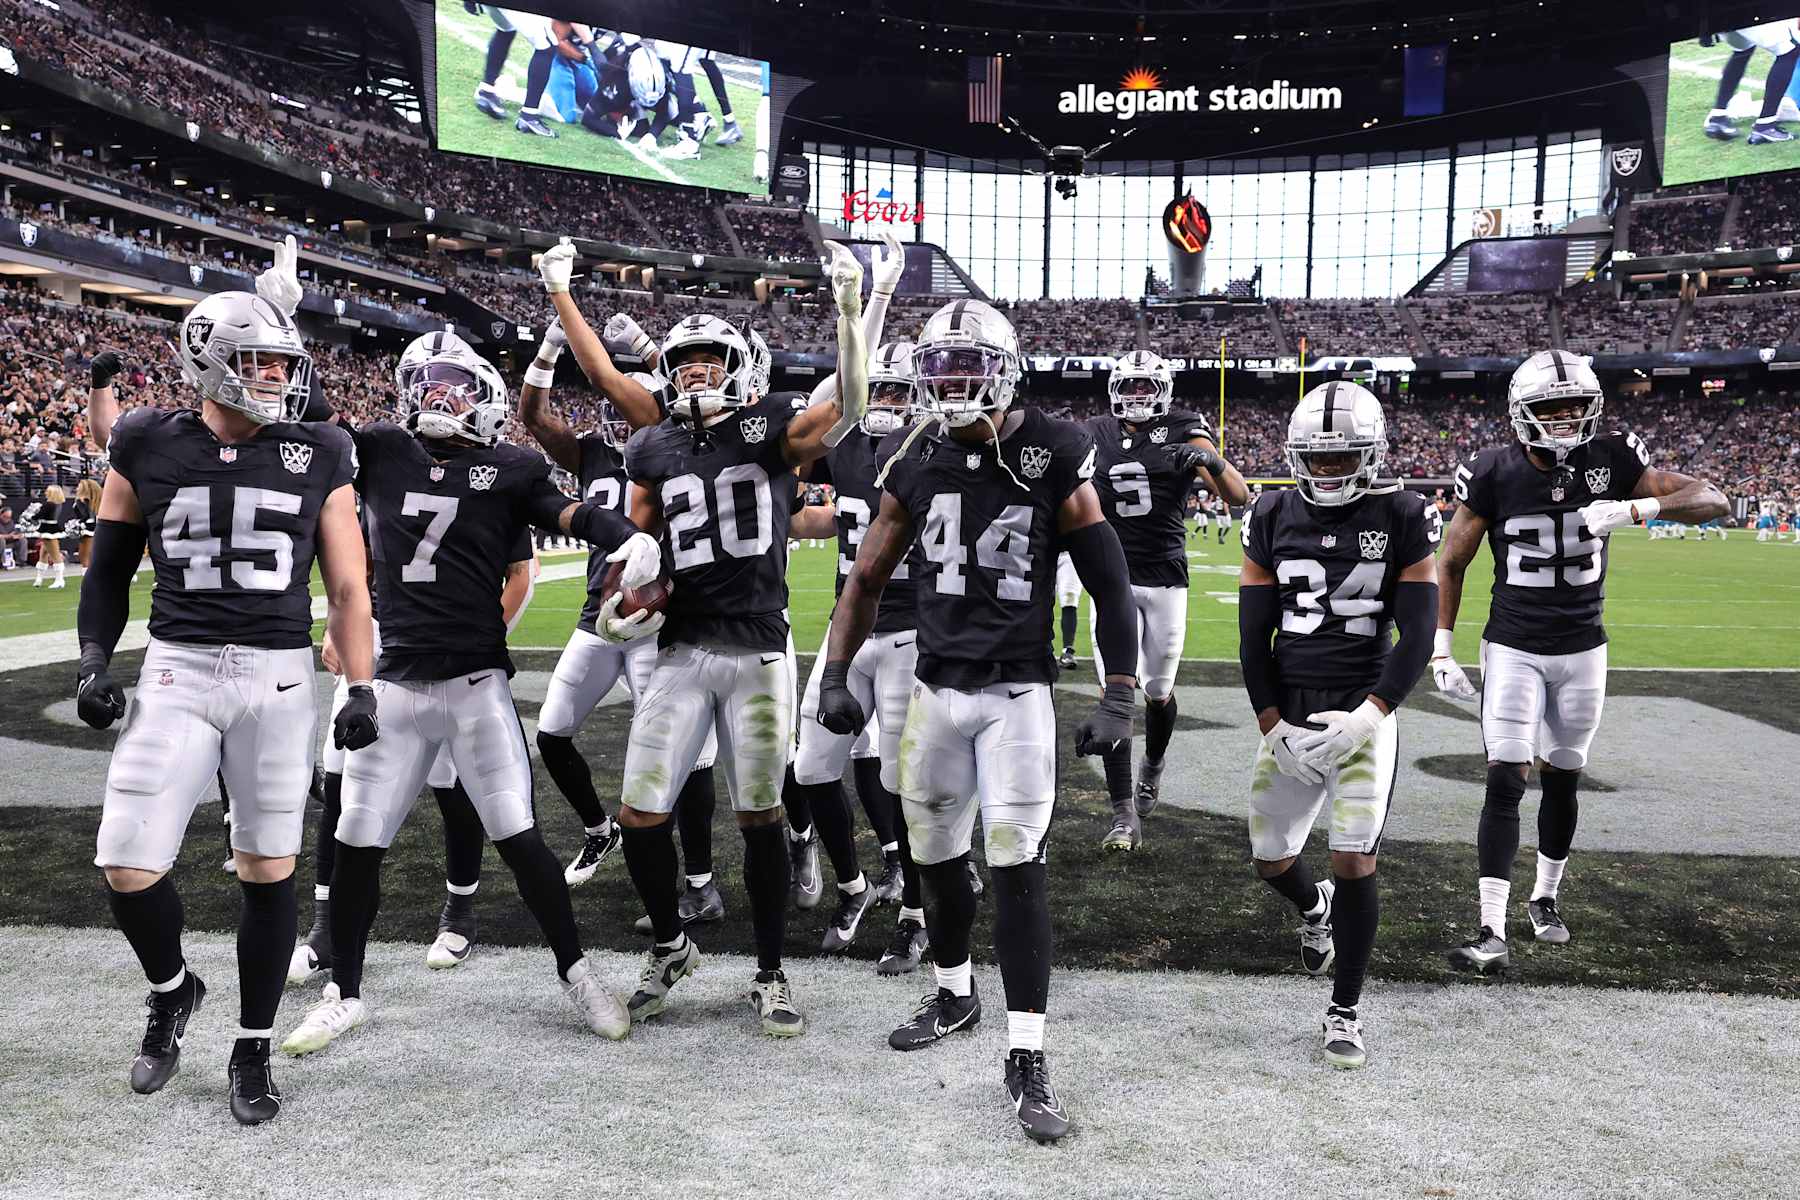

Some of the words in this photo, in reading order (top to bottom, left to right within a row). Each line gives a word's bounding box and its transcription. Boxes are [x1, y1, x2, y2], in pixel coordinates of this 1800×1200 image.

[1057, 84, 1199, 120] allegiant
[1208, 80, 1343, 111] stadium
[841, 189, 925, 224] Coors
[661, 463, 773, 571] 20
[1109, 462, 1152, 517] 9
[161, 486, 302, 591] 45
[401, 491, 460, 582] 7
[921, 493, 1034, 601] 44
[1362, 532, 1387, 554] LXV
[1504, 512, 1603, 588] 25
[1276, 559, 1387, 637] 34
